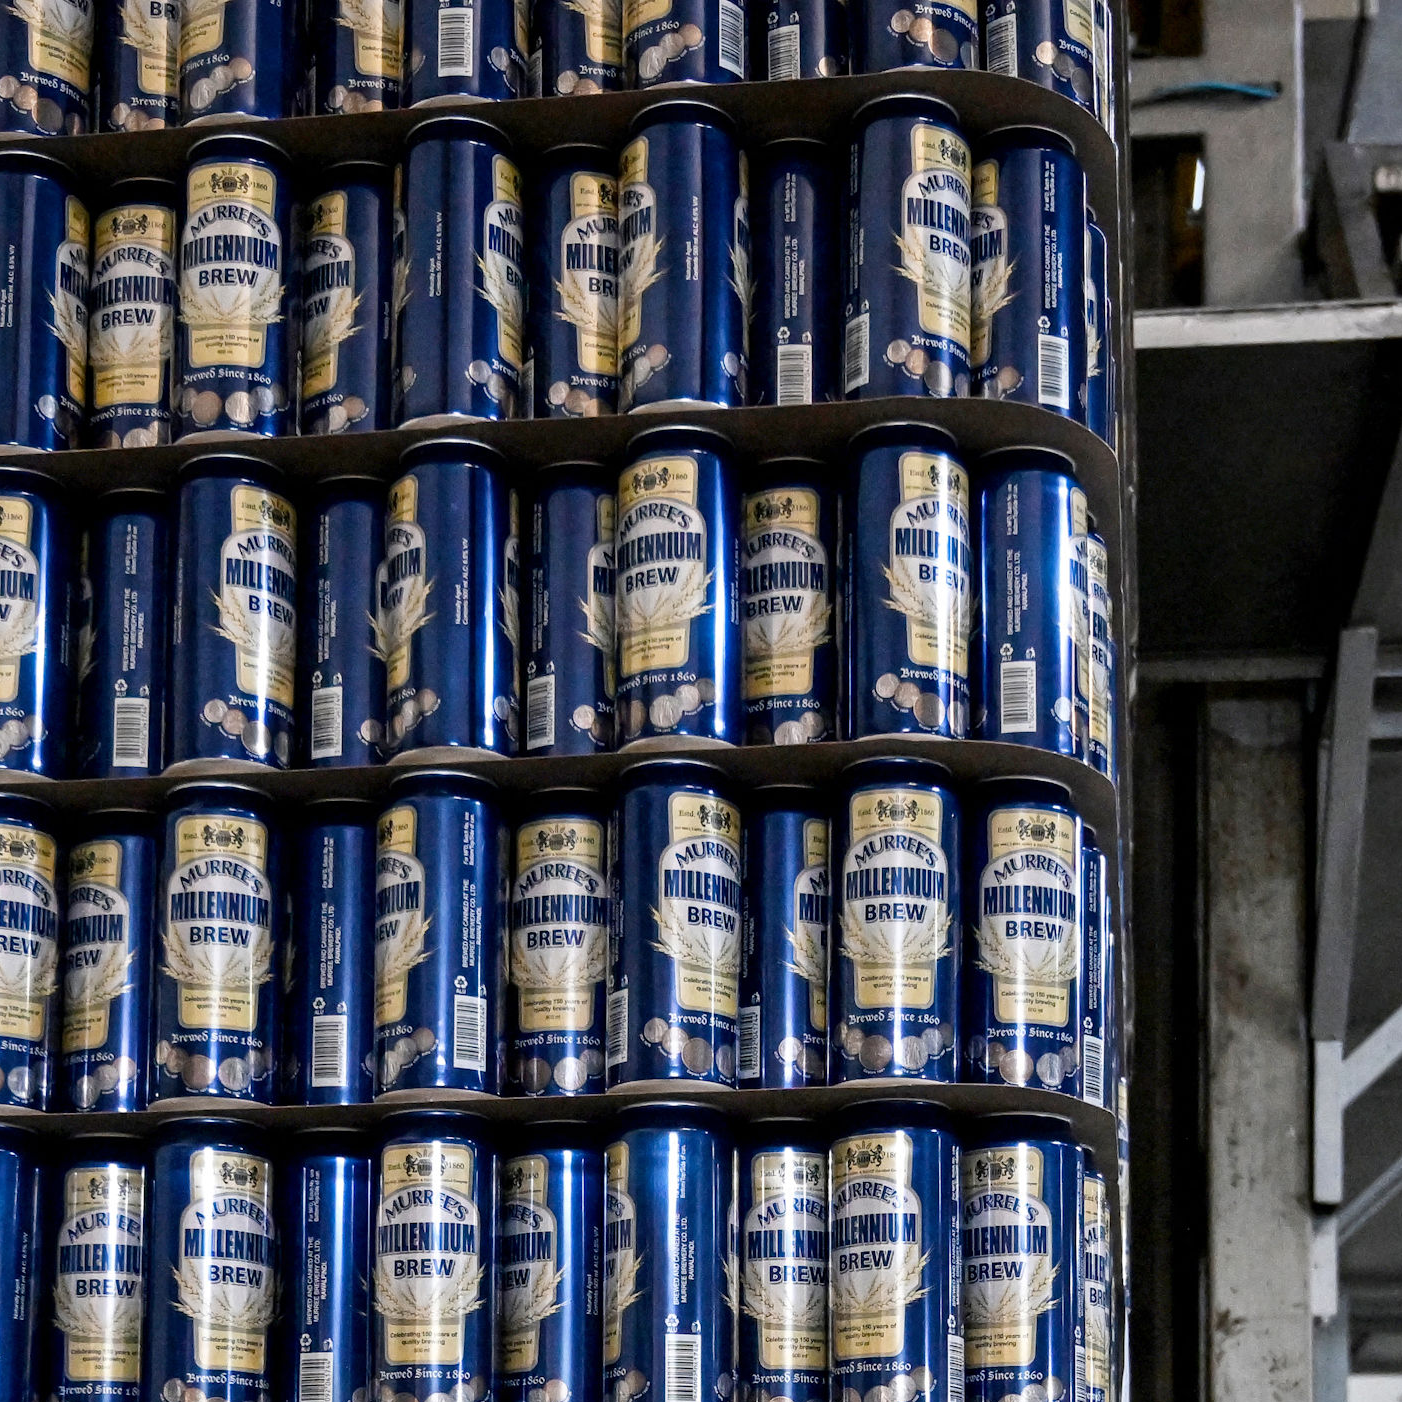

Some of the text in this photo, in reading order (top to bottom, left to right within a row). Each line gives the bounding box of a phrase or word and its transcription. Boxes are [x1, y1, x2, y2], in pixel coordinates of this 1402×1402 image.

[190, 203, 271, 239] MURREE'S
[182, 235, 279, 270] MILLENNIUM
[198, 269, 258, 287] BREW
[184, 368, 272, 385] Brewed Since 1860
[625, 567, 678, 591] BREW
[855, 835, 937, 868] MURREE'S
[179, 860, 264, 895] MURREE'S
[995, 851, 1073, 888] MURREE'S
[846, 865, 945, 900] MILLENNIUM
[171, 892, 269, 926] MILLENNIUM
[983, 884, 1076, 919] MILLENNIUM
[865, 903, 927, 923] BREW
[189, 926, 249, 946] BREW
[1005, 921, 1063, 942] BREW
[849, 1012, 941, 1026] Brewed 1860
[2, 1040, 28, 1053] Since
[172, 1032, 263, 1050] Brewed Since 1860
[1029, 1029, 1054, 1041] Since
[1055, 1032, 1074, 1043] 1860
[394, 1257, 455, 1278] BREW
[380, 1368, 414, 1382] Brewed
[417, 1368, 444, 1381] Since
